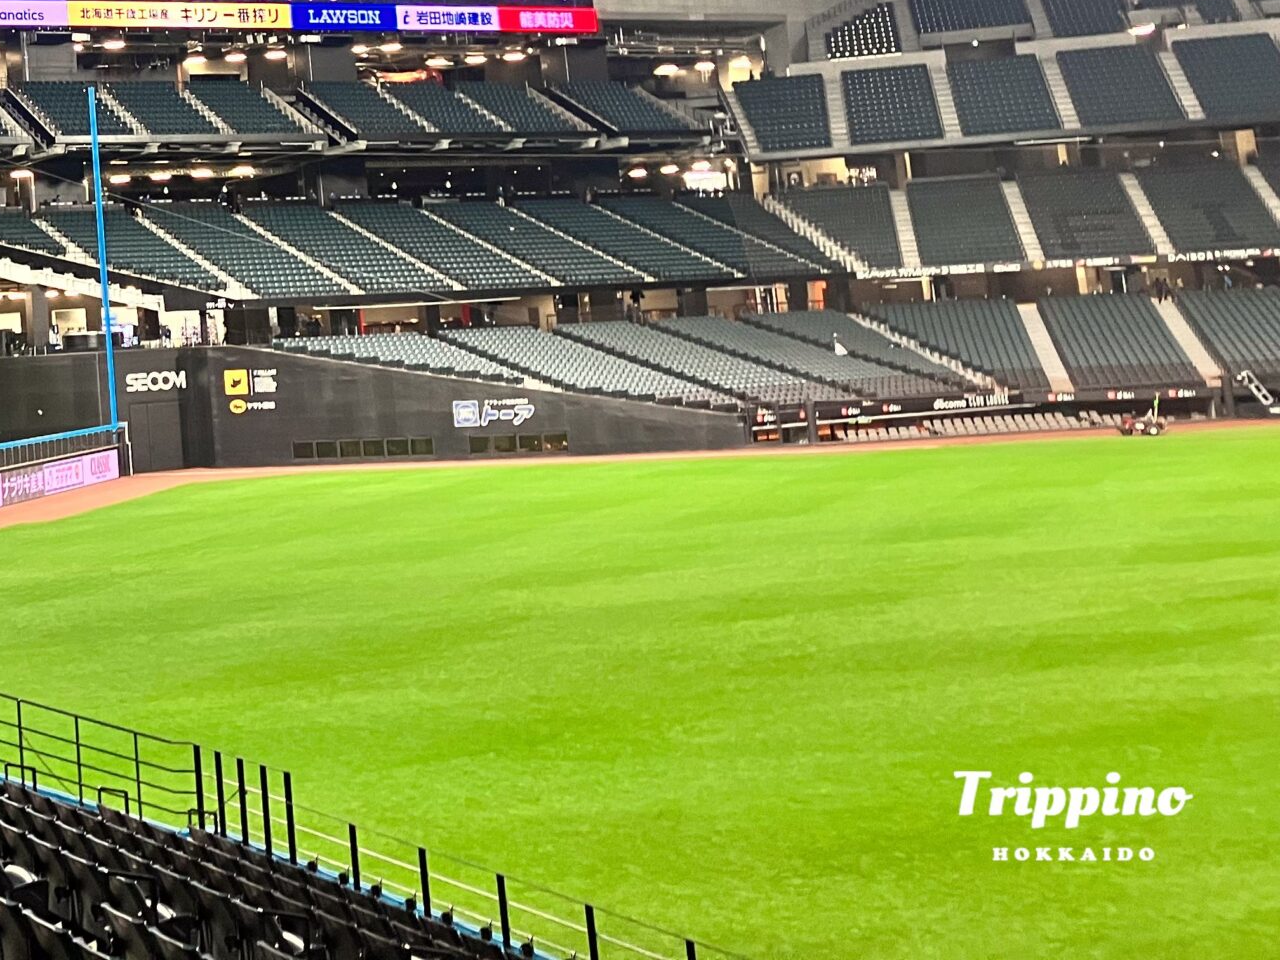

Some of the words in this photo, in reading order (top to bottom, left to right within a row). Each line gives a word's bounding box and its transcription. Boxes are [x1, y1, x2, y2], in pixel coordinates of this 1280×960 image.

[180, 7, 280, 24] キリン一番搾り
[308, 9, 381, 24] LAWSON
[416, 10, 494, 27] 岩田地崎建設
[125, 370, 187, 393] SECOM
[481, 404, 535, 427] トーア
